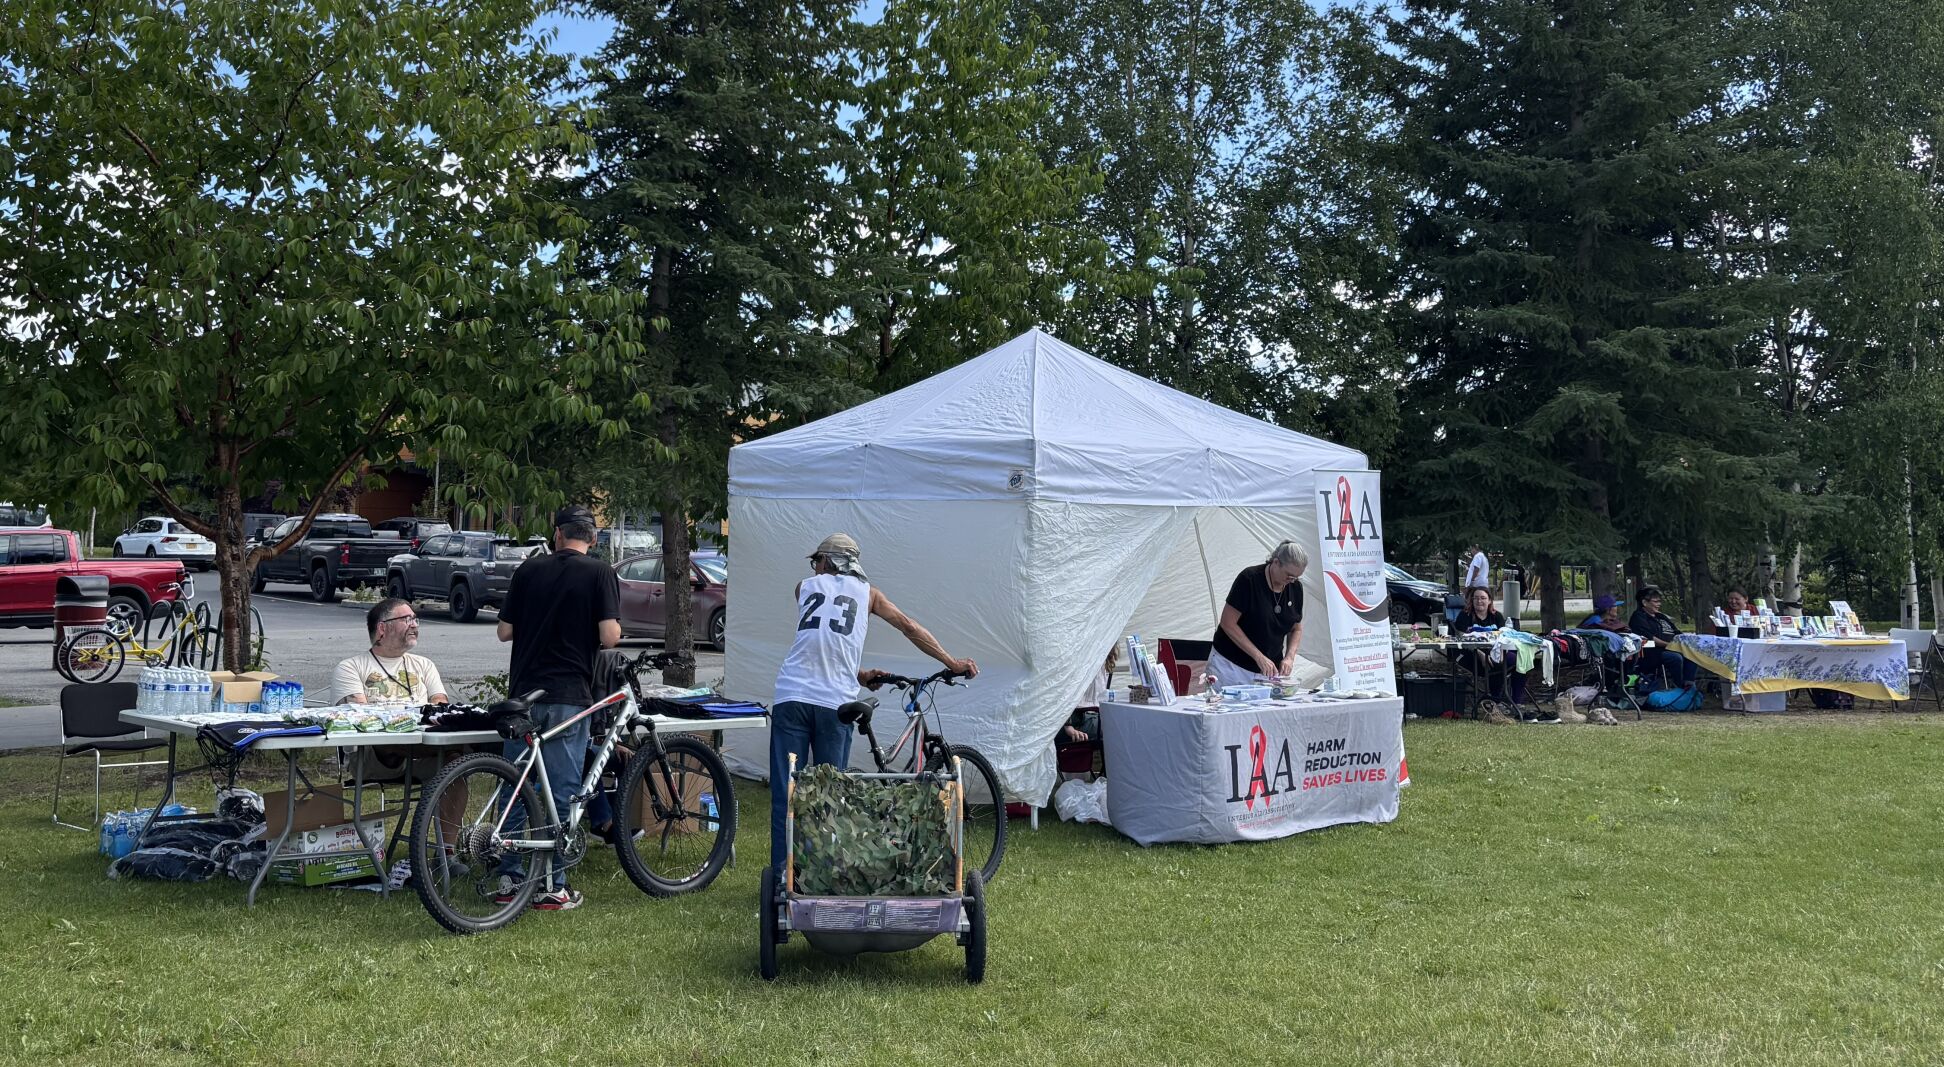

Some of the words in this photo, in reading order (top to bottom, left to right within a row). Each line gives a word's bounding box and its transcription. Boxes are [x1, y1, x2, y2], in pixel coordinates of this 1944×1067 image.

[1320, 489, 1380, 540] IAA
[798, 592, 858, 636] 23
[1304, 752, 1382, 773] REDUCTION
[1306, 738, 1346, 756] HARM
[1224, 738, 1297, 803] IAA
[1302, 771, 1342, 791] SAVES
[1344, 768, 1388, 784] LIVES.
